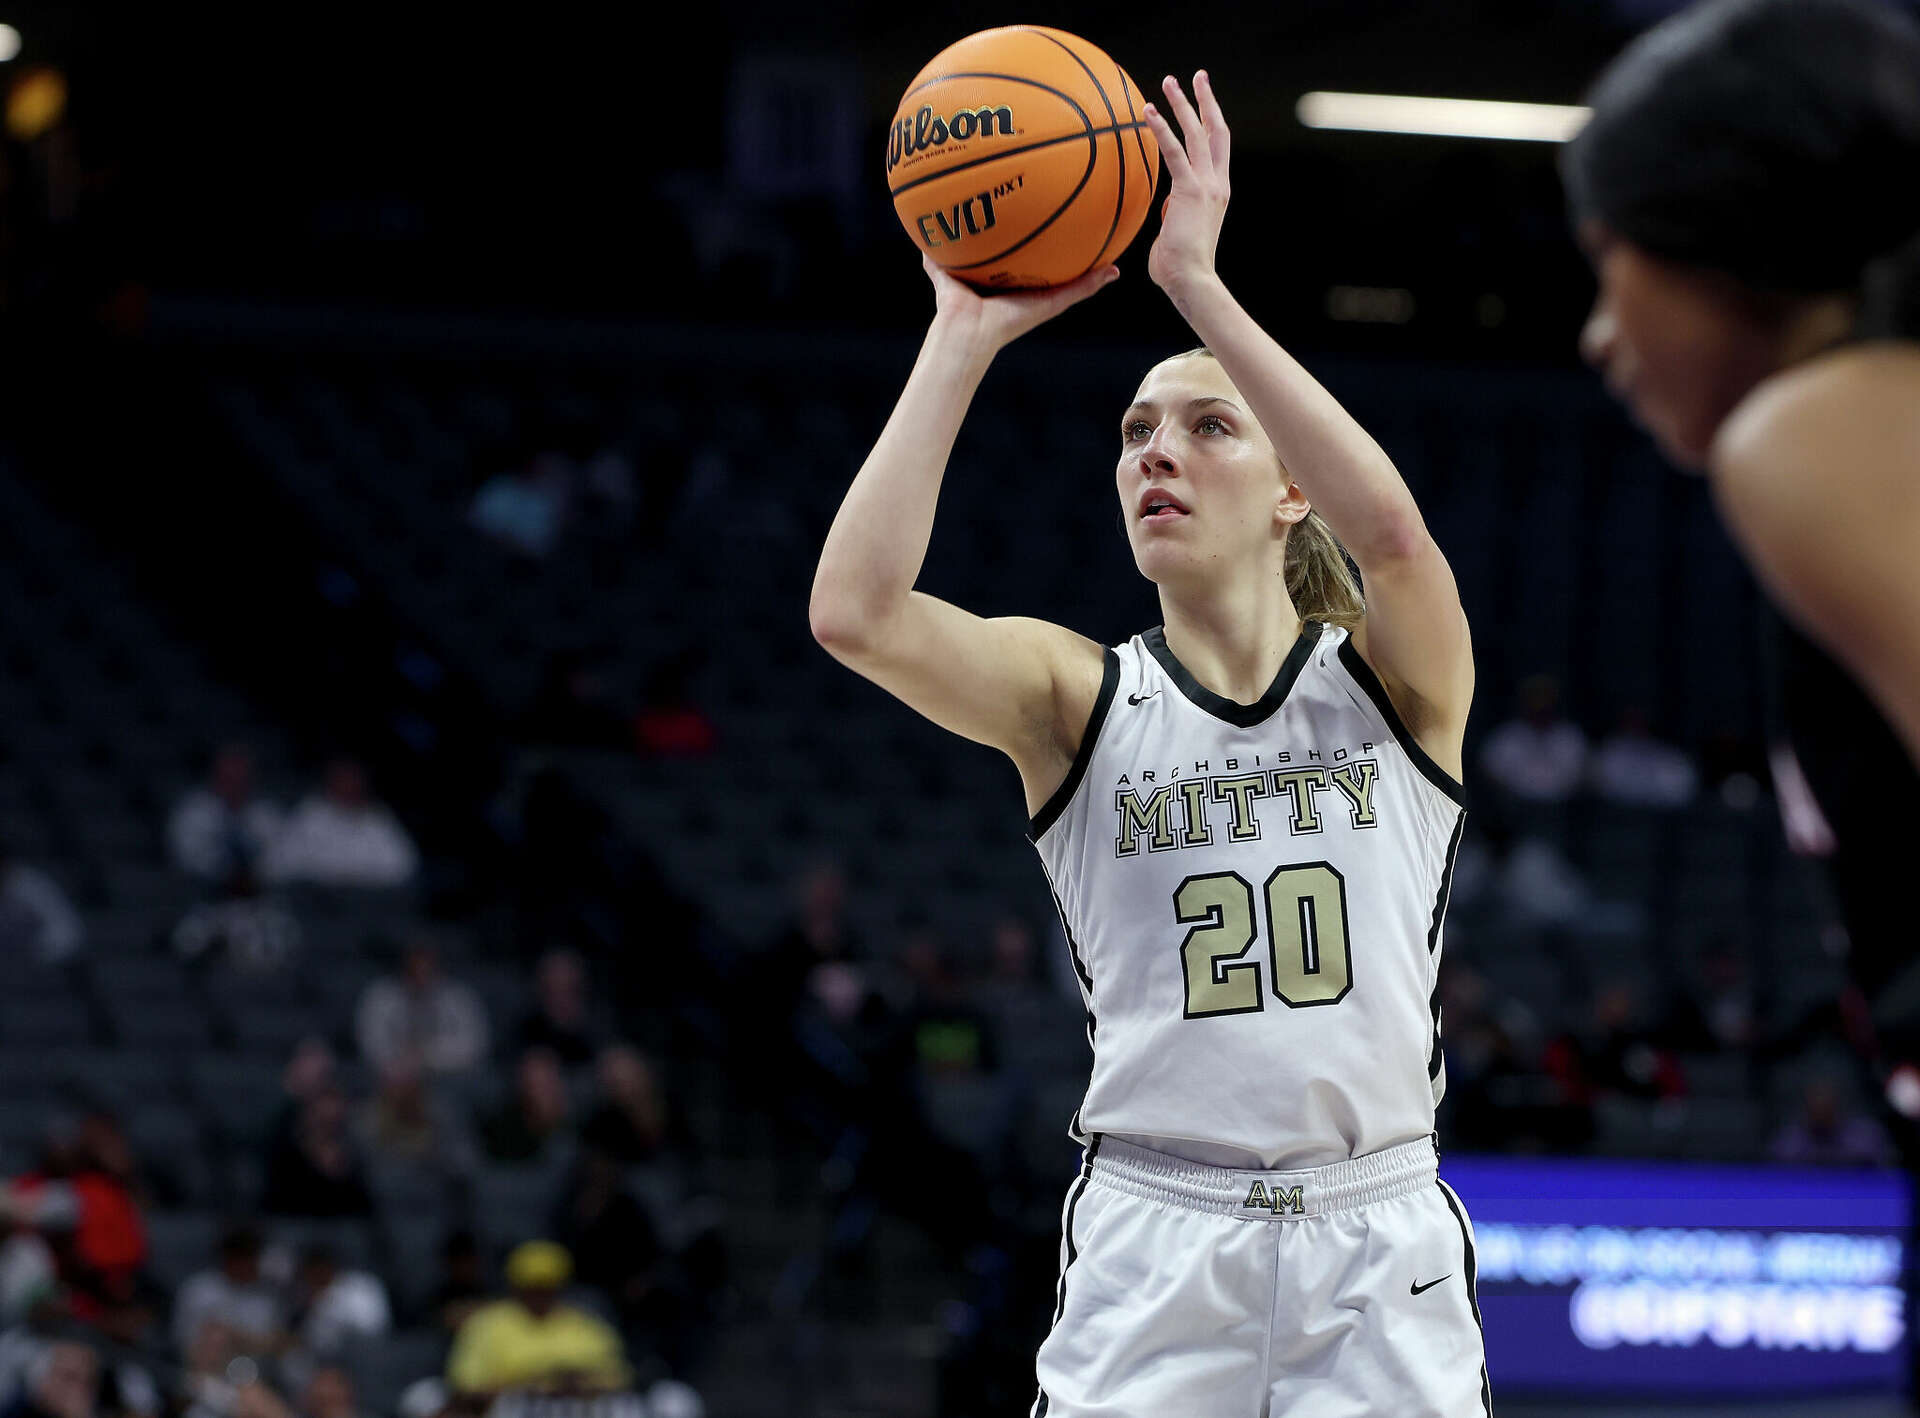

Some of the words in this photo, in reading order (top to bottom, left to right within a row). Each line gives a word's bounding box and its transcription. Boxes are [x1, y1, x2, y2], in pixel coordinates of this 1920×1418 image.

[993, 172, 1024, 200] NXT
[1117, 742, 1374, 786] ARCHBISHOP
[1115, 758, 1379, 859] MITTY
[1172, 860, 1354, 1020] 20
[1243, 1179, 1306, 1215] AM
